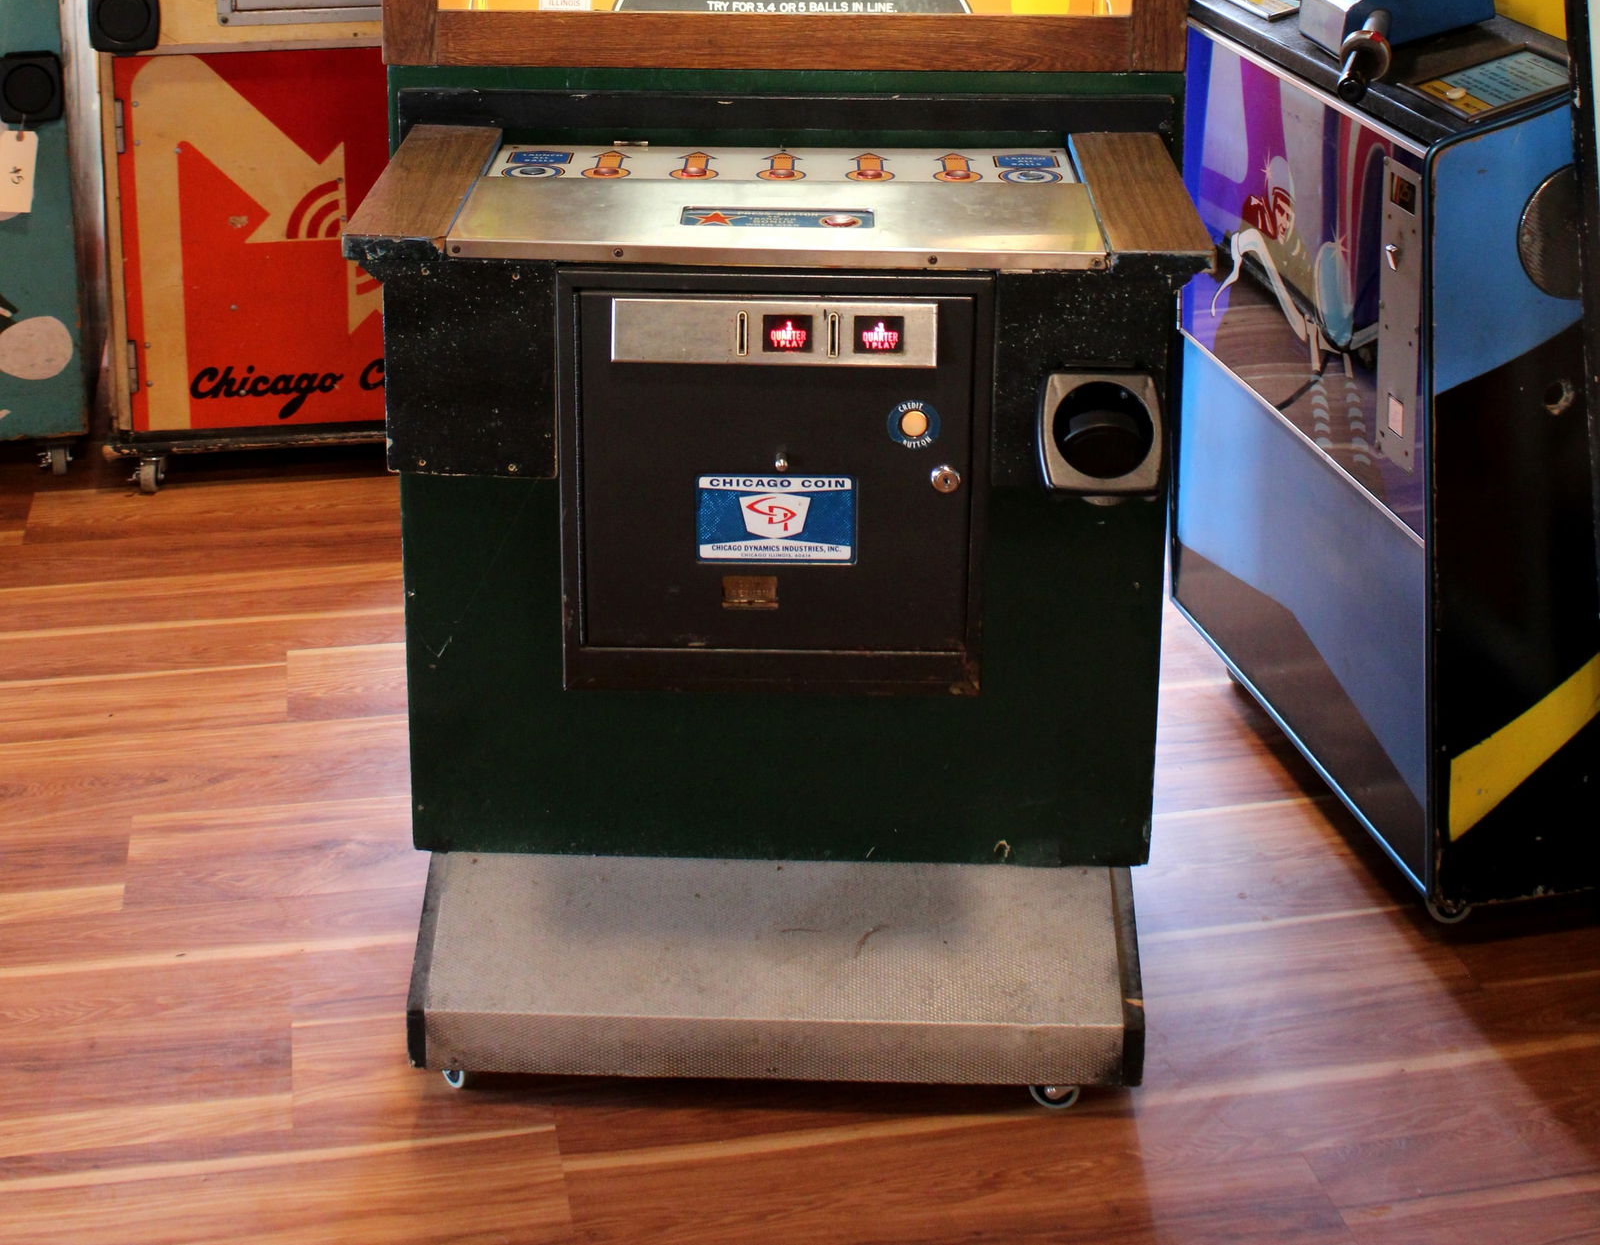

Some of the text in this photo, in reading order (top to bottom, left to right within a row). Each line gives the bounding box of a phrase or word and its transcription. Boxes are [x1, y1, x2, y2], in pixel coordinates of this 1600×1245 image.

[707, 0, 729, 12] TRY
[732, 1, 754, 13] FOR
[780, 2, 796, 13] OR
[798, 2, 806, 13] 5
[809, 2, 849, 13] BALLS
[852, 2, 864, 13] IN
[866, 2, 898, 14] LINE.
[770, 330, 807, 341] QUARTER
[862, 331, 899, 342] QUARTER
[780, 340, 805, 348] PLAY
[872, 341, 896, 349] PLAY
[190, 365, 344, 420] Chicago
[898, 402, 923, 413] CREDIT
[902, 435, 932, 449] BUTTON
[709, 478, 846, 489] CHICAGO COIN
[711, 544, 743, 552] CHICAGO
[744, 544, 780, 552] DYNAMICS
[782, 545, 826, 553] INDUSTRIES,
